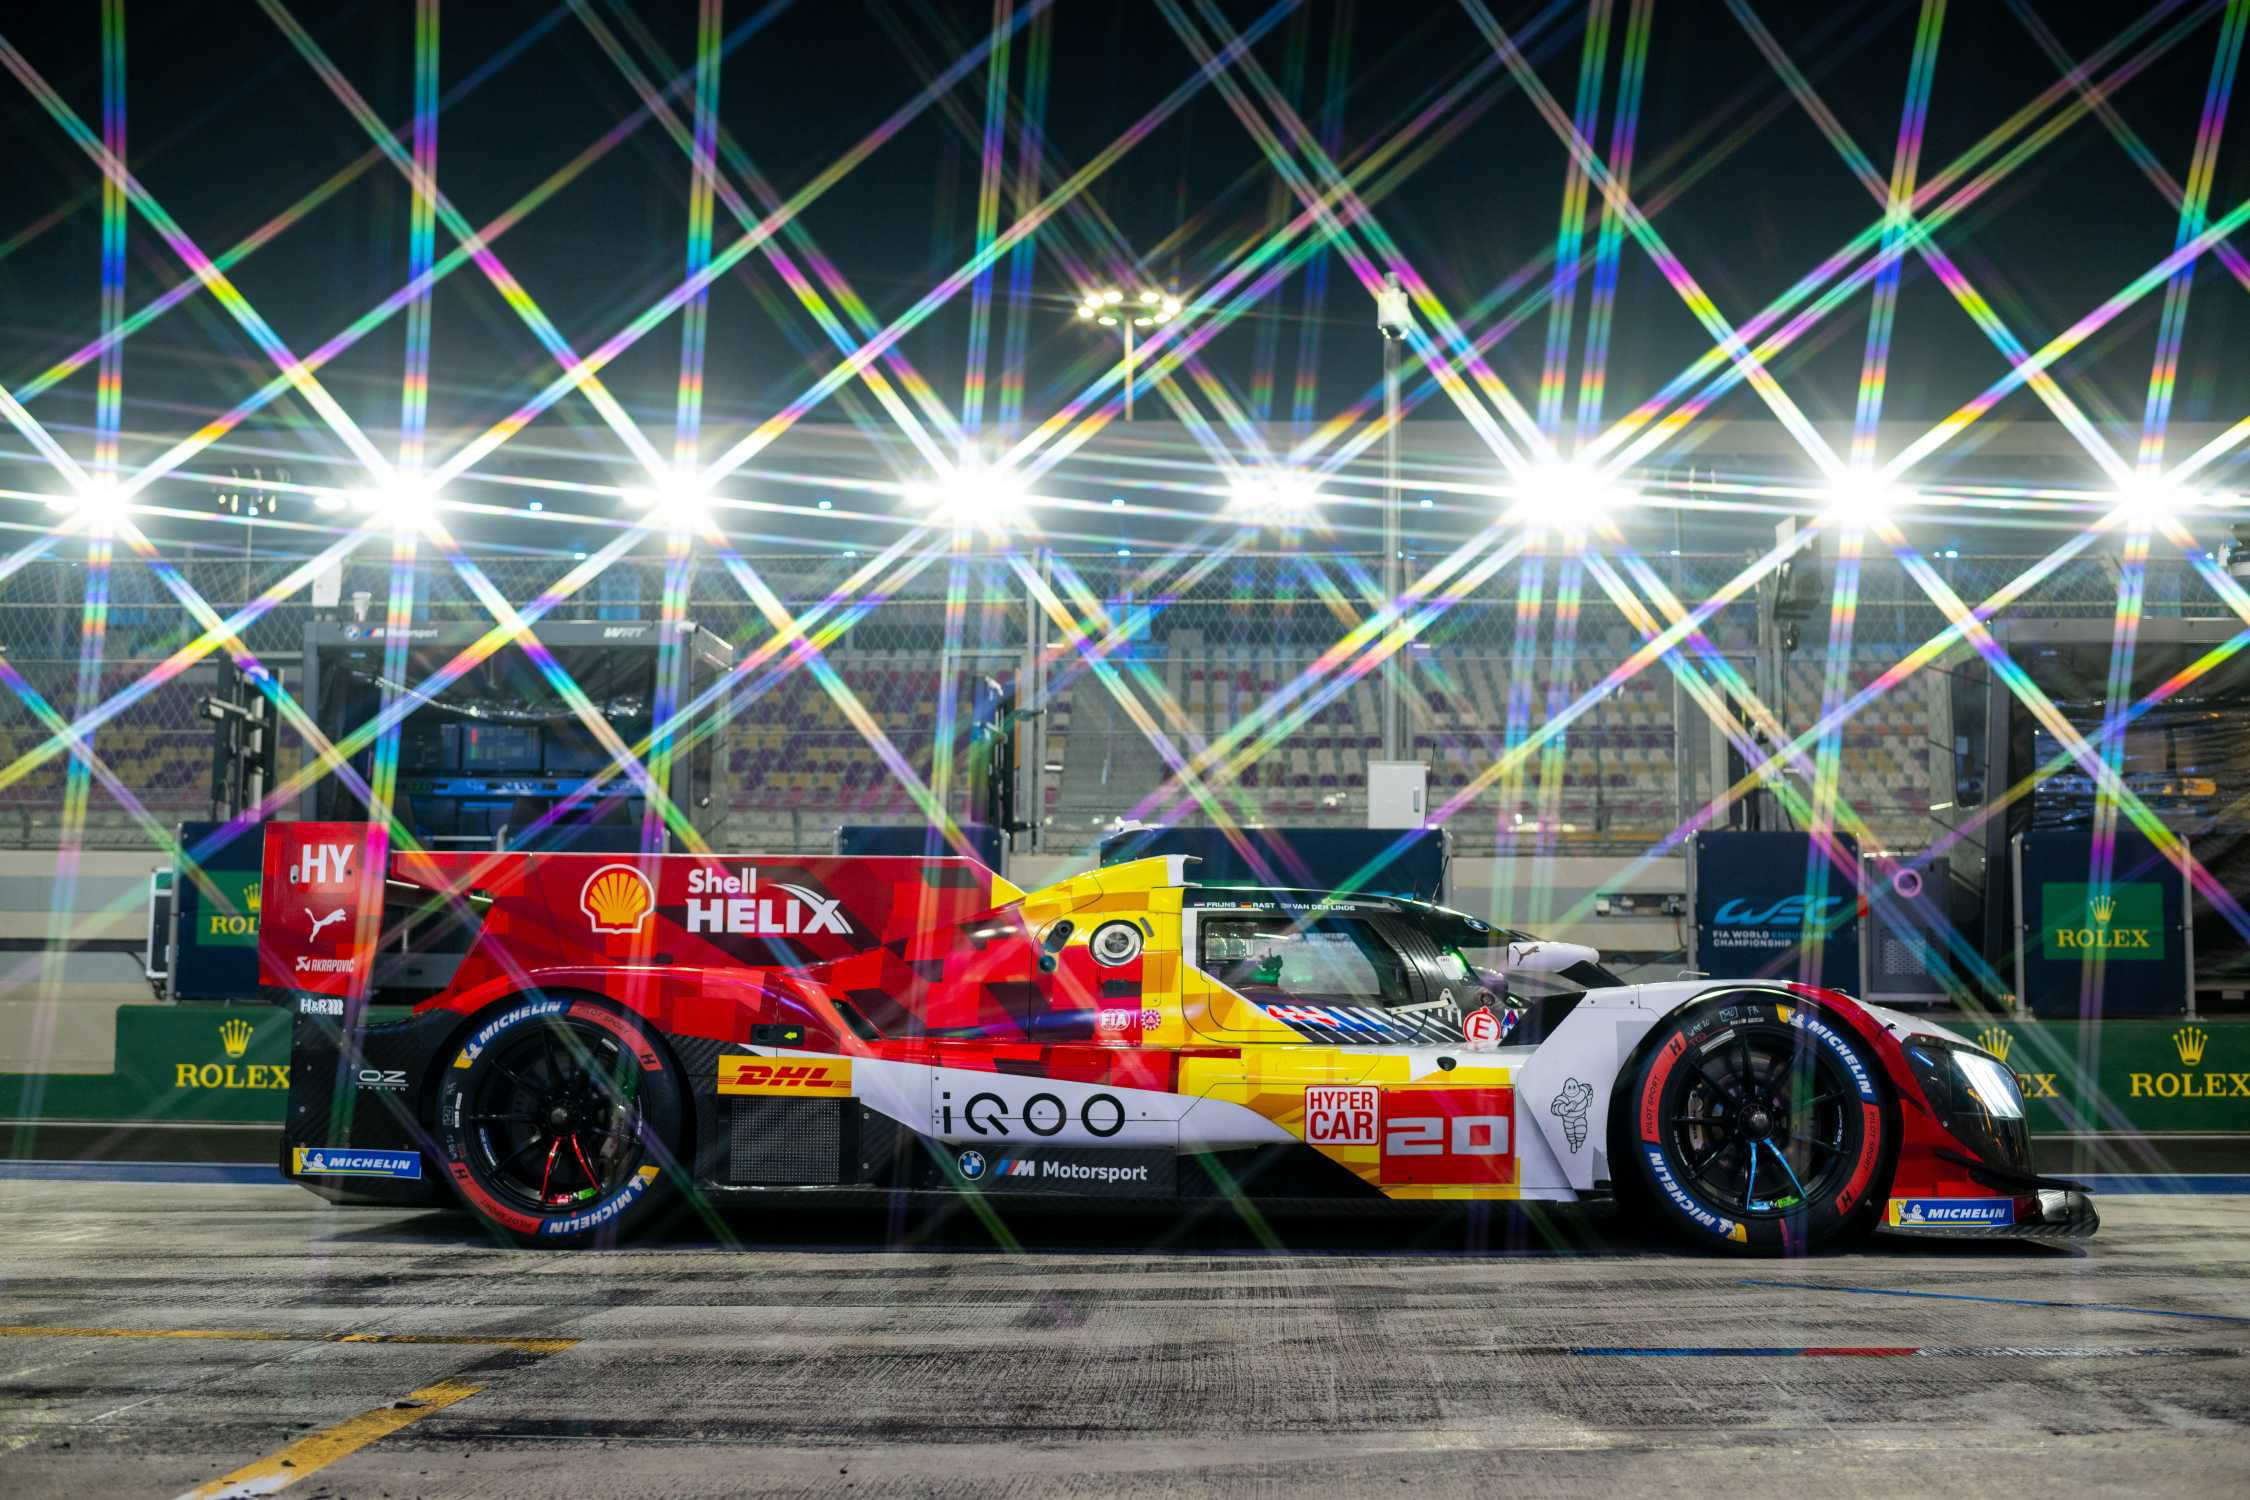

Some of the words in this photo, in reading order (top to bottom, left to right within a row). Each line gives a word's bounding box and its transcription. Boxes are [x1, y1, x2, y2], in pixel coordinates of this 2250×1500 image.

[301, 844, 354, 883] HY
[688, 868, 757, 894] Shell
[685, 890, 854, 934] HELIX
[210, 915, 260, 935] ROL
[1713, 931, 1730, 939] FIA
[1731, 931, 1769, 939] WORLD
[1713, 939, 1792, 948] CHAMPIONSHIP
[2056, 928, 2150, 948] ROLEX
[480, 1001, 562, 1044] MICHELIN
[1101, 1012, 1127, 1026] FIA
[1473, 1017, 1492, 1041] E
[1669, 1038, 1683, 1056] H
[1807, 1020, 1873, 1094] MICHELIN
[640, 1053, 657, 1065] H
[175, 1064, 290, 1088] ROLEX
[735, 1065, 834, 1088] DHL
[2129, 1073, 2250, 1098] ROLEX
[1310, 1091, 1373, 1110] HYPER
[943, 1092, 1125, 1137] iQOO
[1310, 1111, 1373, 1140] CAR
[1386, 1115, 1509, 1156] 20
[329, 1156, 411, 1169] MICHELIN
[1042, 1161, 1148, 1183] Motorsport
[1649, 1152, 1716, 1227] MICHELIN
[1841, 1190, 1853, 1206] H
[549, 1190, 633, 1233] MICHELIN
[1927, 1208, 2006, 1219] MICHELIN
